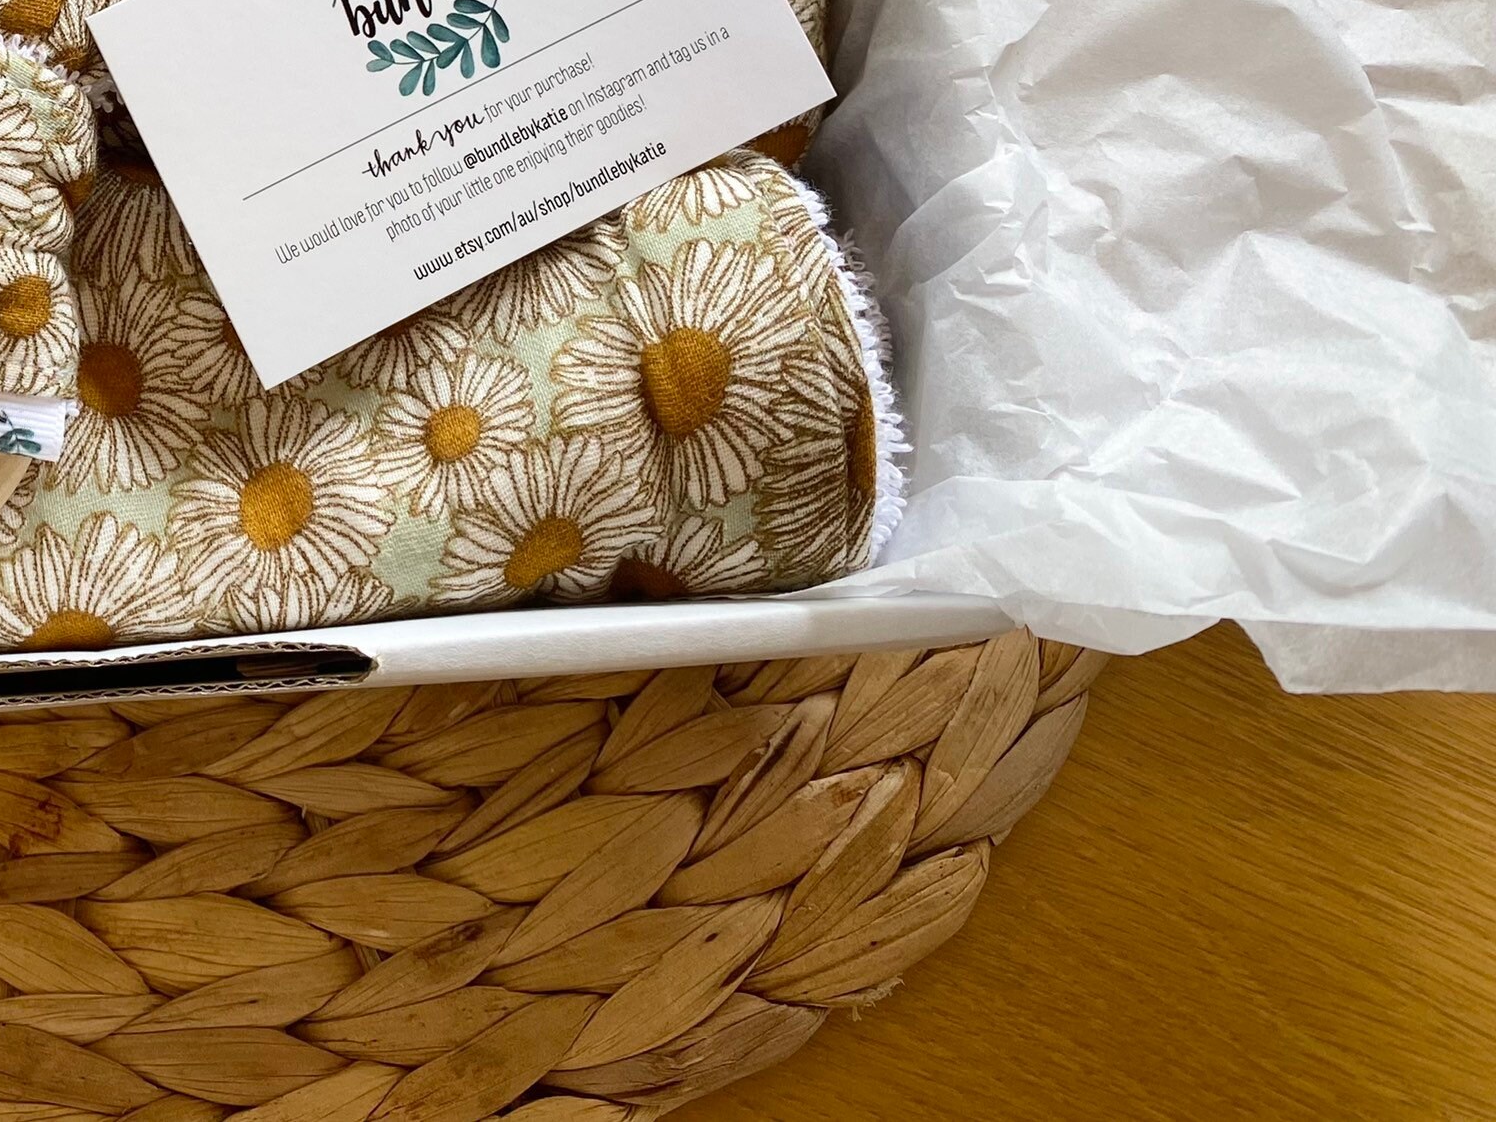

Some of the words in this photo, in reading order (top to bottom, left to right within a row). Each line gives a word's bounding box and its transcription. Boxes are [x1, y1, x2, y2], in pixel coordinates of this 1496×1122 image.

[274, 242, 301, 265] We
[298, 219, 341, 253] would
[337, 210, 367, 233] love
[364, 199, 385, 223] for
[384, 187, 411, 211] you
[407, 181, 424, 197] to
[421, 160, 464, 194] follow
[462, 107, 569, 170] @bundlebykatie
[567, 98, 586, 117] on
[581, 67, 648, 108] Instagram
[646, 52, 672, 77] and
[668, 46, 693, 65] tag
[689, 37, 708, 55] us
[703, 30, 722, 47] in
[719, 26, 731, 41] a
[360, 130, 435, 179] thank
[435, 112, 486, 148] you
[483, 100, 504, 124] for
[503, 85, 533, 113] your
[533, 51, 595, 99] purchase!
[385, 212, 422, 243] photo
[420, 201, 437, 222] of
[433, 190, 463, 217] your
[461, 175, 494, 200] little
[492, 164, 517, 185] one
[515, 139, 568, 174] enjoying
[563, 123, 595, 148] their
[595, 93, 648, 136] goodies!
[412, 141, 667, 281] www.etsy.com/au/shop/bundlebykatie
